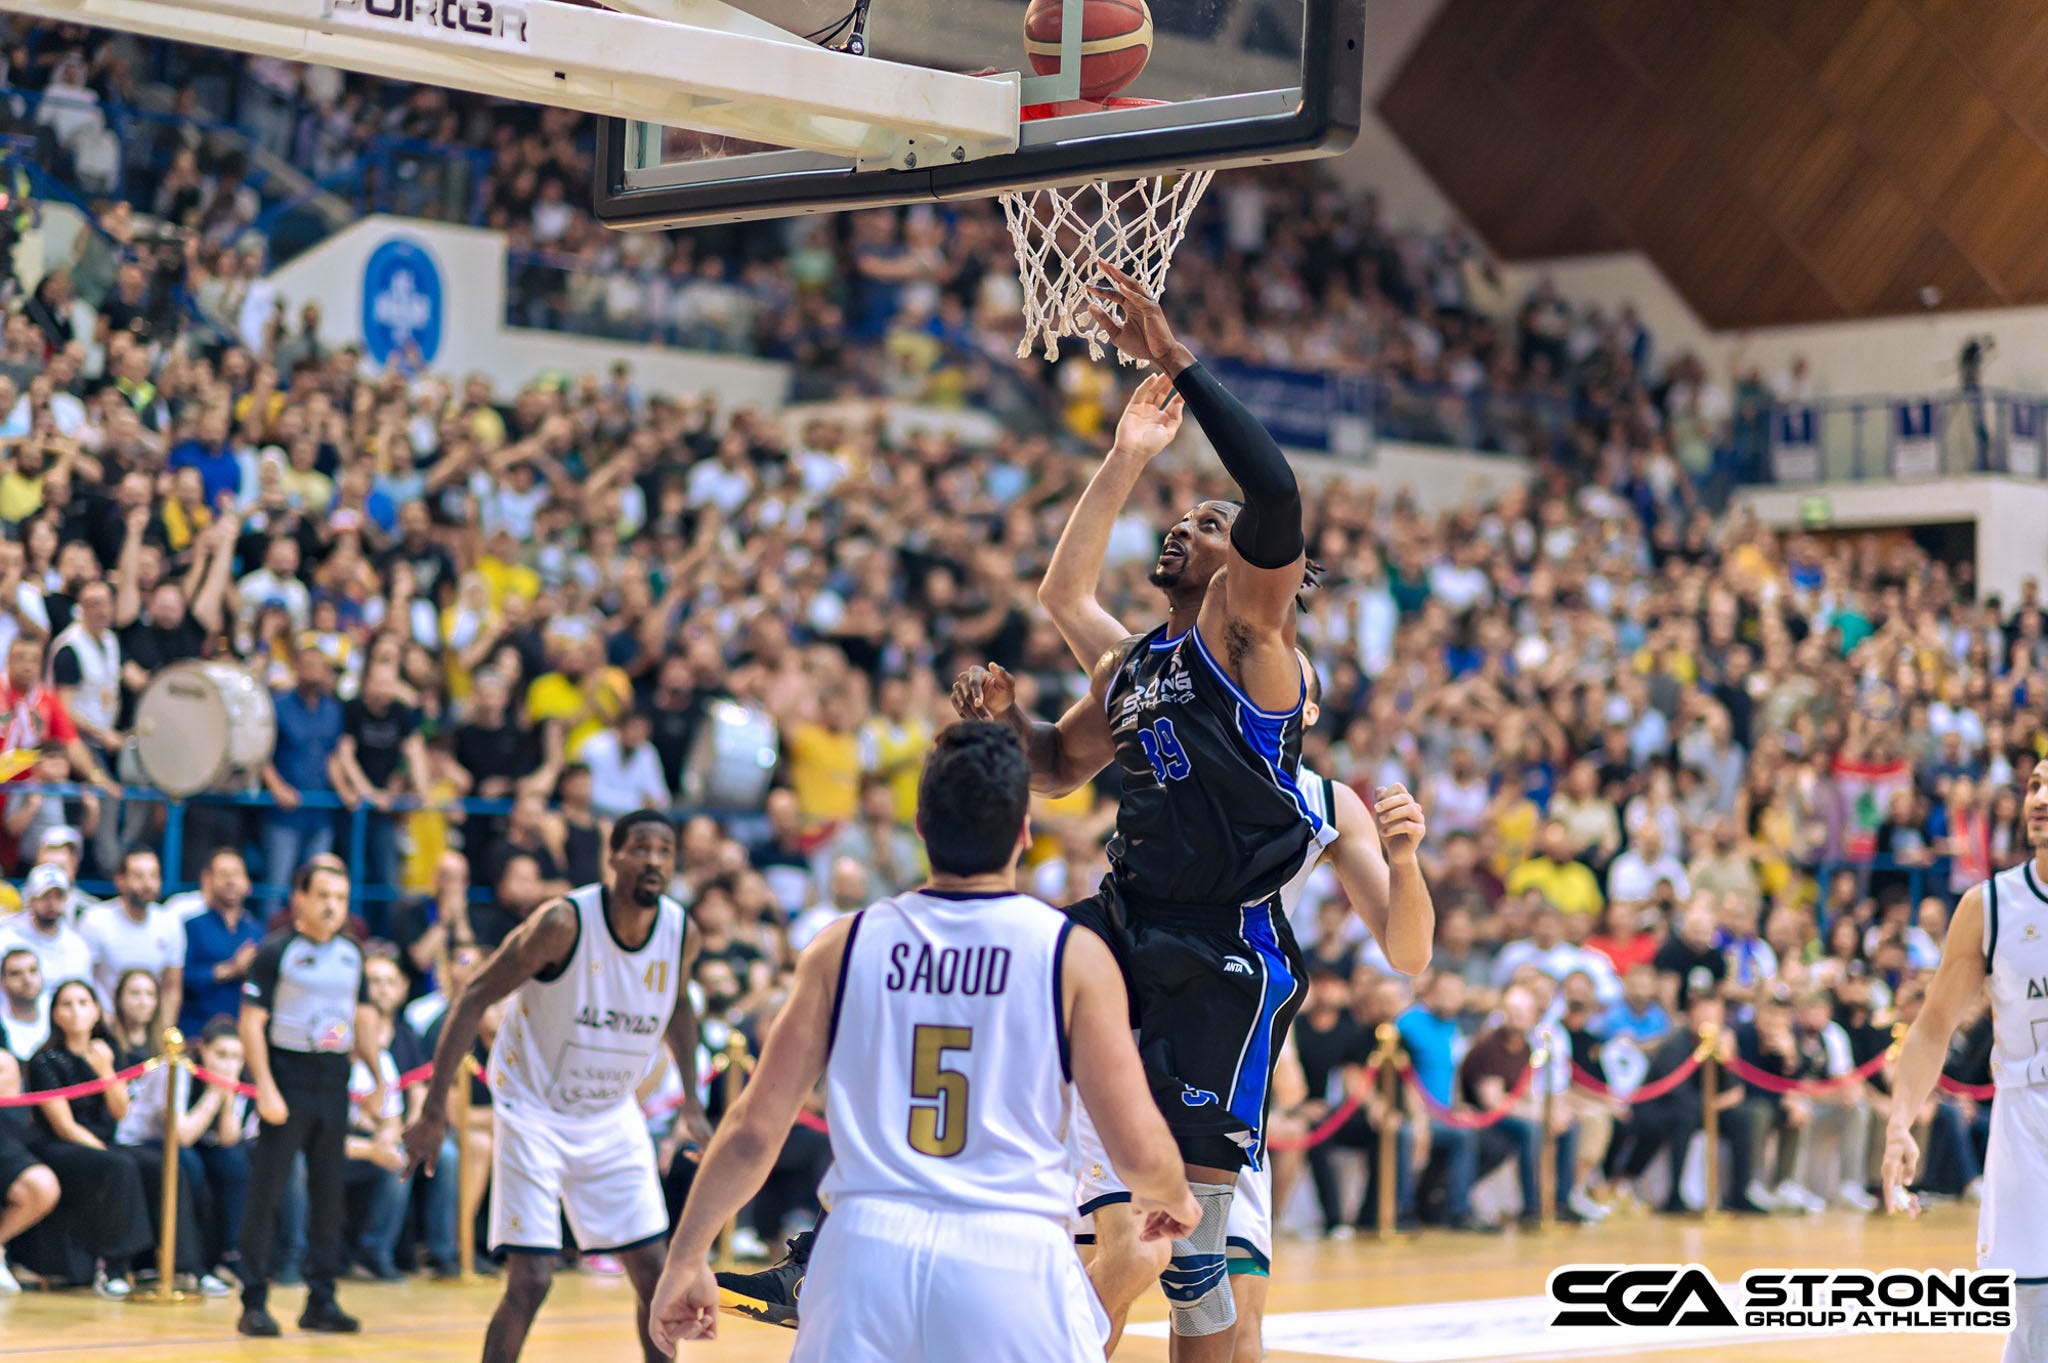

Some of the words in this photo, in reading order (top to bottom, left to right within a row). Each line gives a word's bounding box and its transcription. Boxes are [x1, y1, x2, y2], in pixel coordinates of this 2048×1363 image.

[643, 960, 668, 994] 41
[886, 942, 1012, 996] SAOUD
[1223, 962, 1243, 973] ANTA
[907, 1023, 973, 1159] 5
